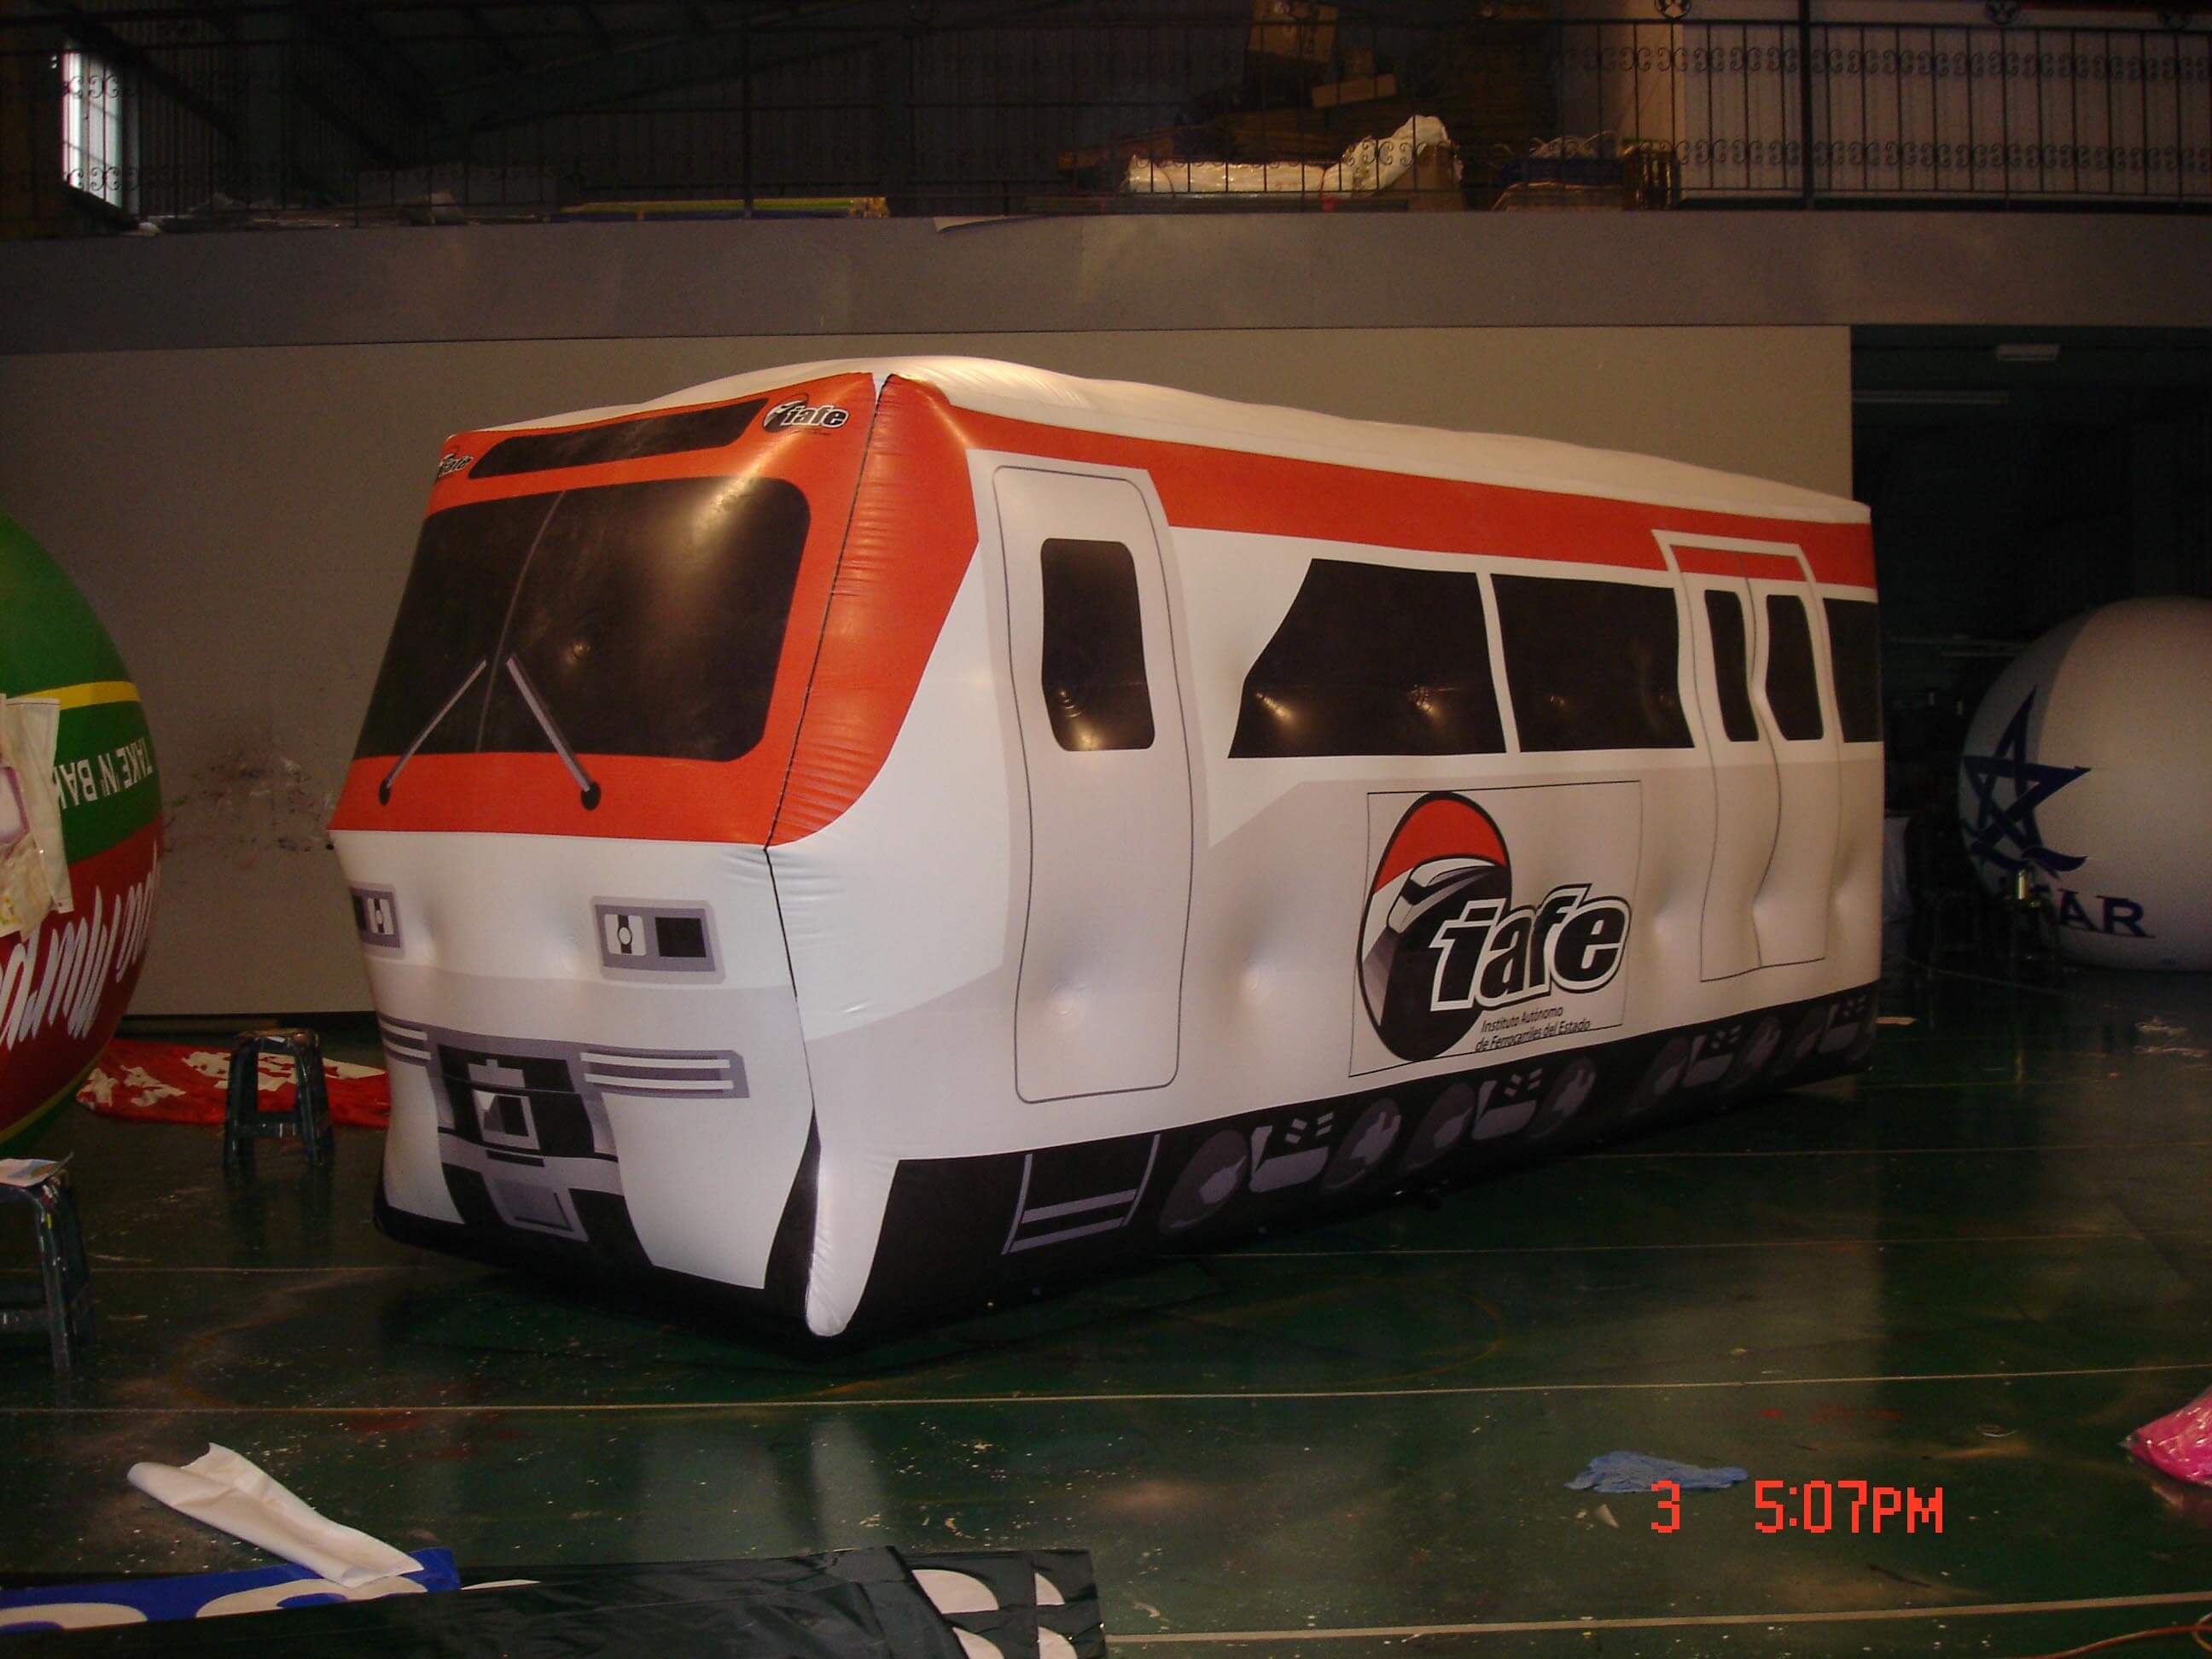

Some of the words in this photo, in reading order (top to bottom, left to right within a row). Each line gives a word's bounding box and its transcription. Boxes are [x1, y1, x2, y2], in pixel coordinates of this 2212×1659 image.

[115, 736, 154, 789] TAKE
[1475, 1037, 1490, 1052] de
[1543, 1022, 1559, 1039] del
[1559, 1017, 1592, 1035] Estado
[1481, 1016, 1520, 1033] Instituto
